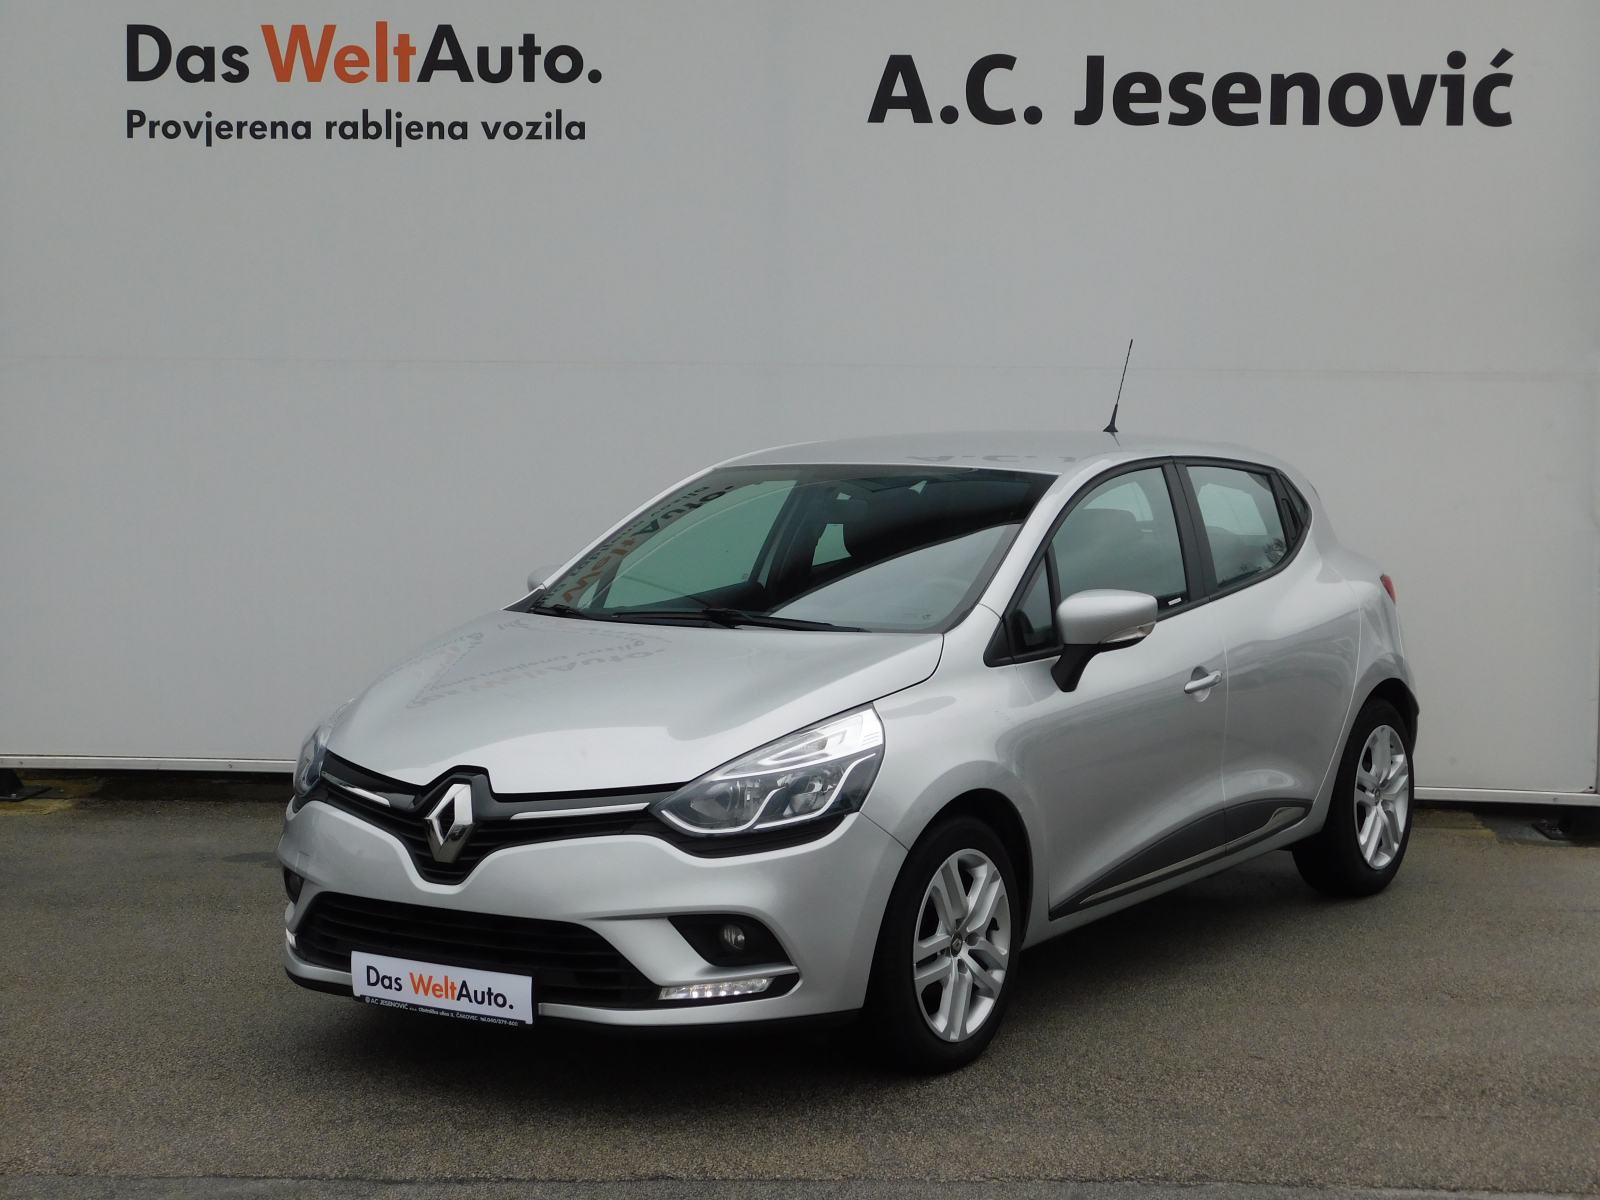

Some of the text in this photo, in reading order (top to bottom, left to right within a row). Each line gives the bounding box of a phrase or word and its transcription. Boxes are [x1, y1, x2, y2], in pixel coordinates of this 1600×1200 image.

[127, 20, 603, 84] Das WeltAuto.
[867, 47, 1515, 128] A.C. Jesenović
[127, 108, 586, 148] Provjerena rabljena vozila
[366, 964, 514, 1010] Das WeltAuto.
